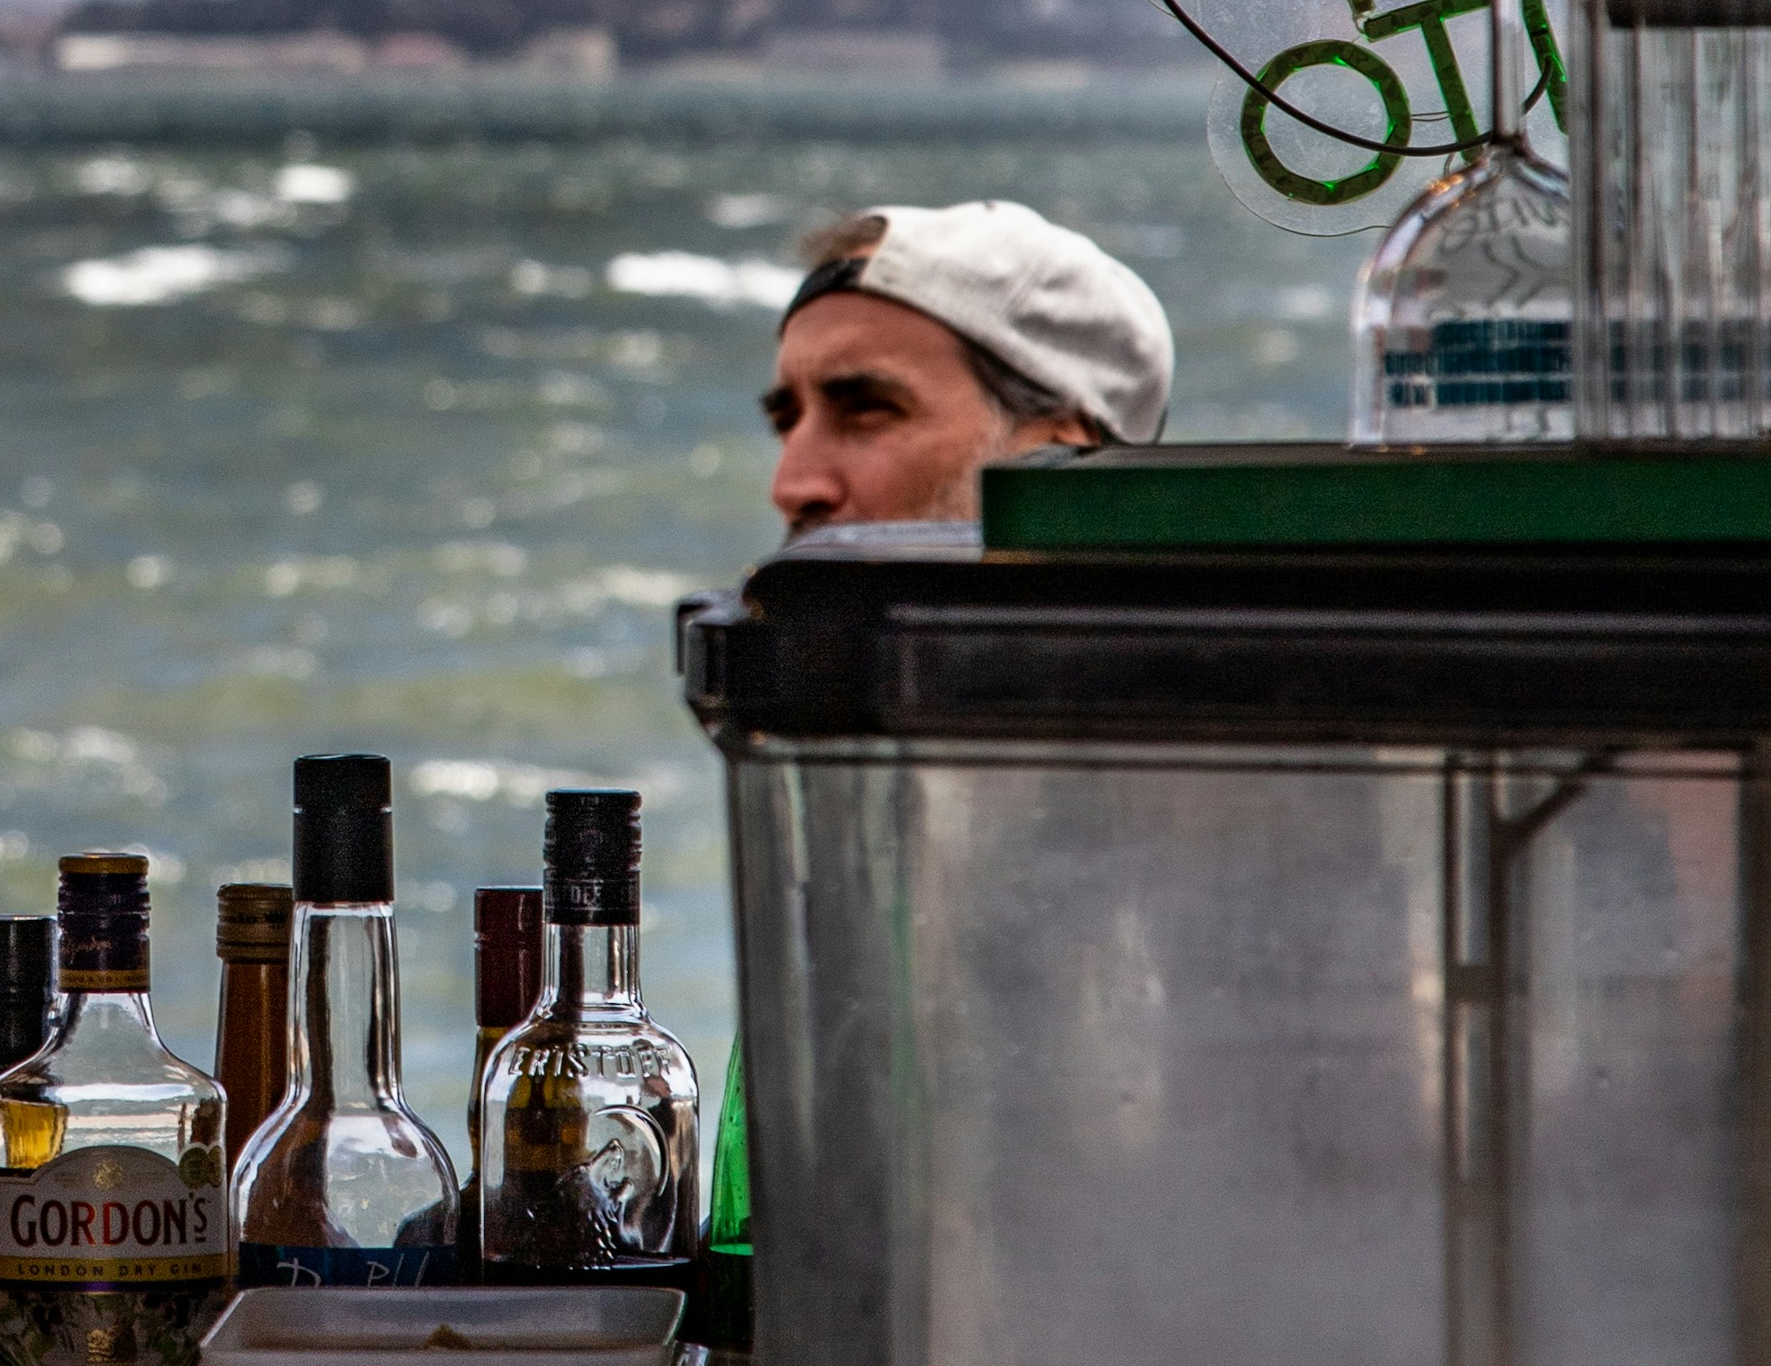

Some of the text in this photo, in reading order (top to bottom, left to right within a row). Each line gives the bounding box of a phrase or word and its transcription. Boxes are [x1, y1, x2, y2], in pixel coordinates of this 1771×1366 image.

[11, 1191, 208, 1248] GORDON'S
[17, 1262, 203, 1276] LONDON DRY GIN
